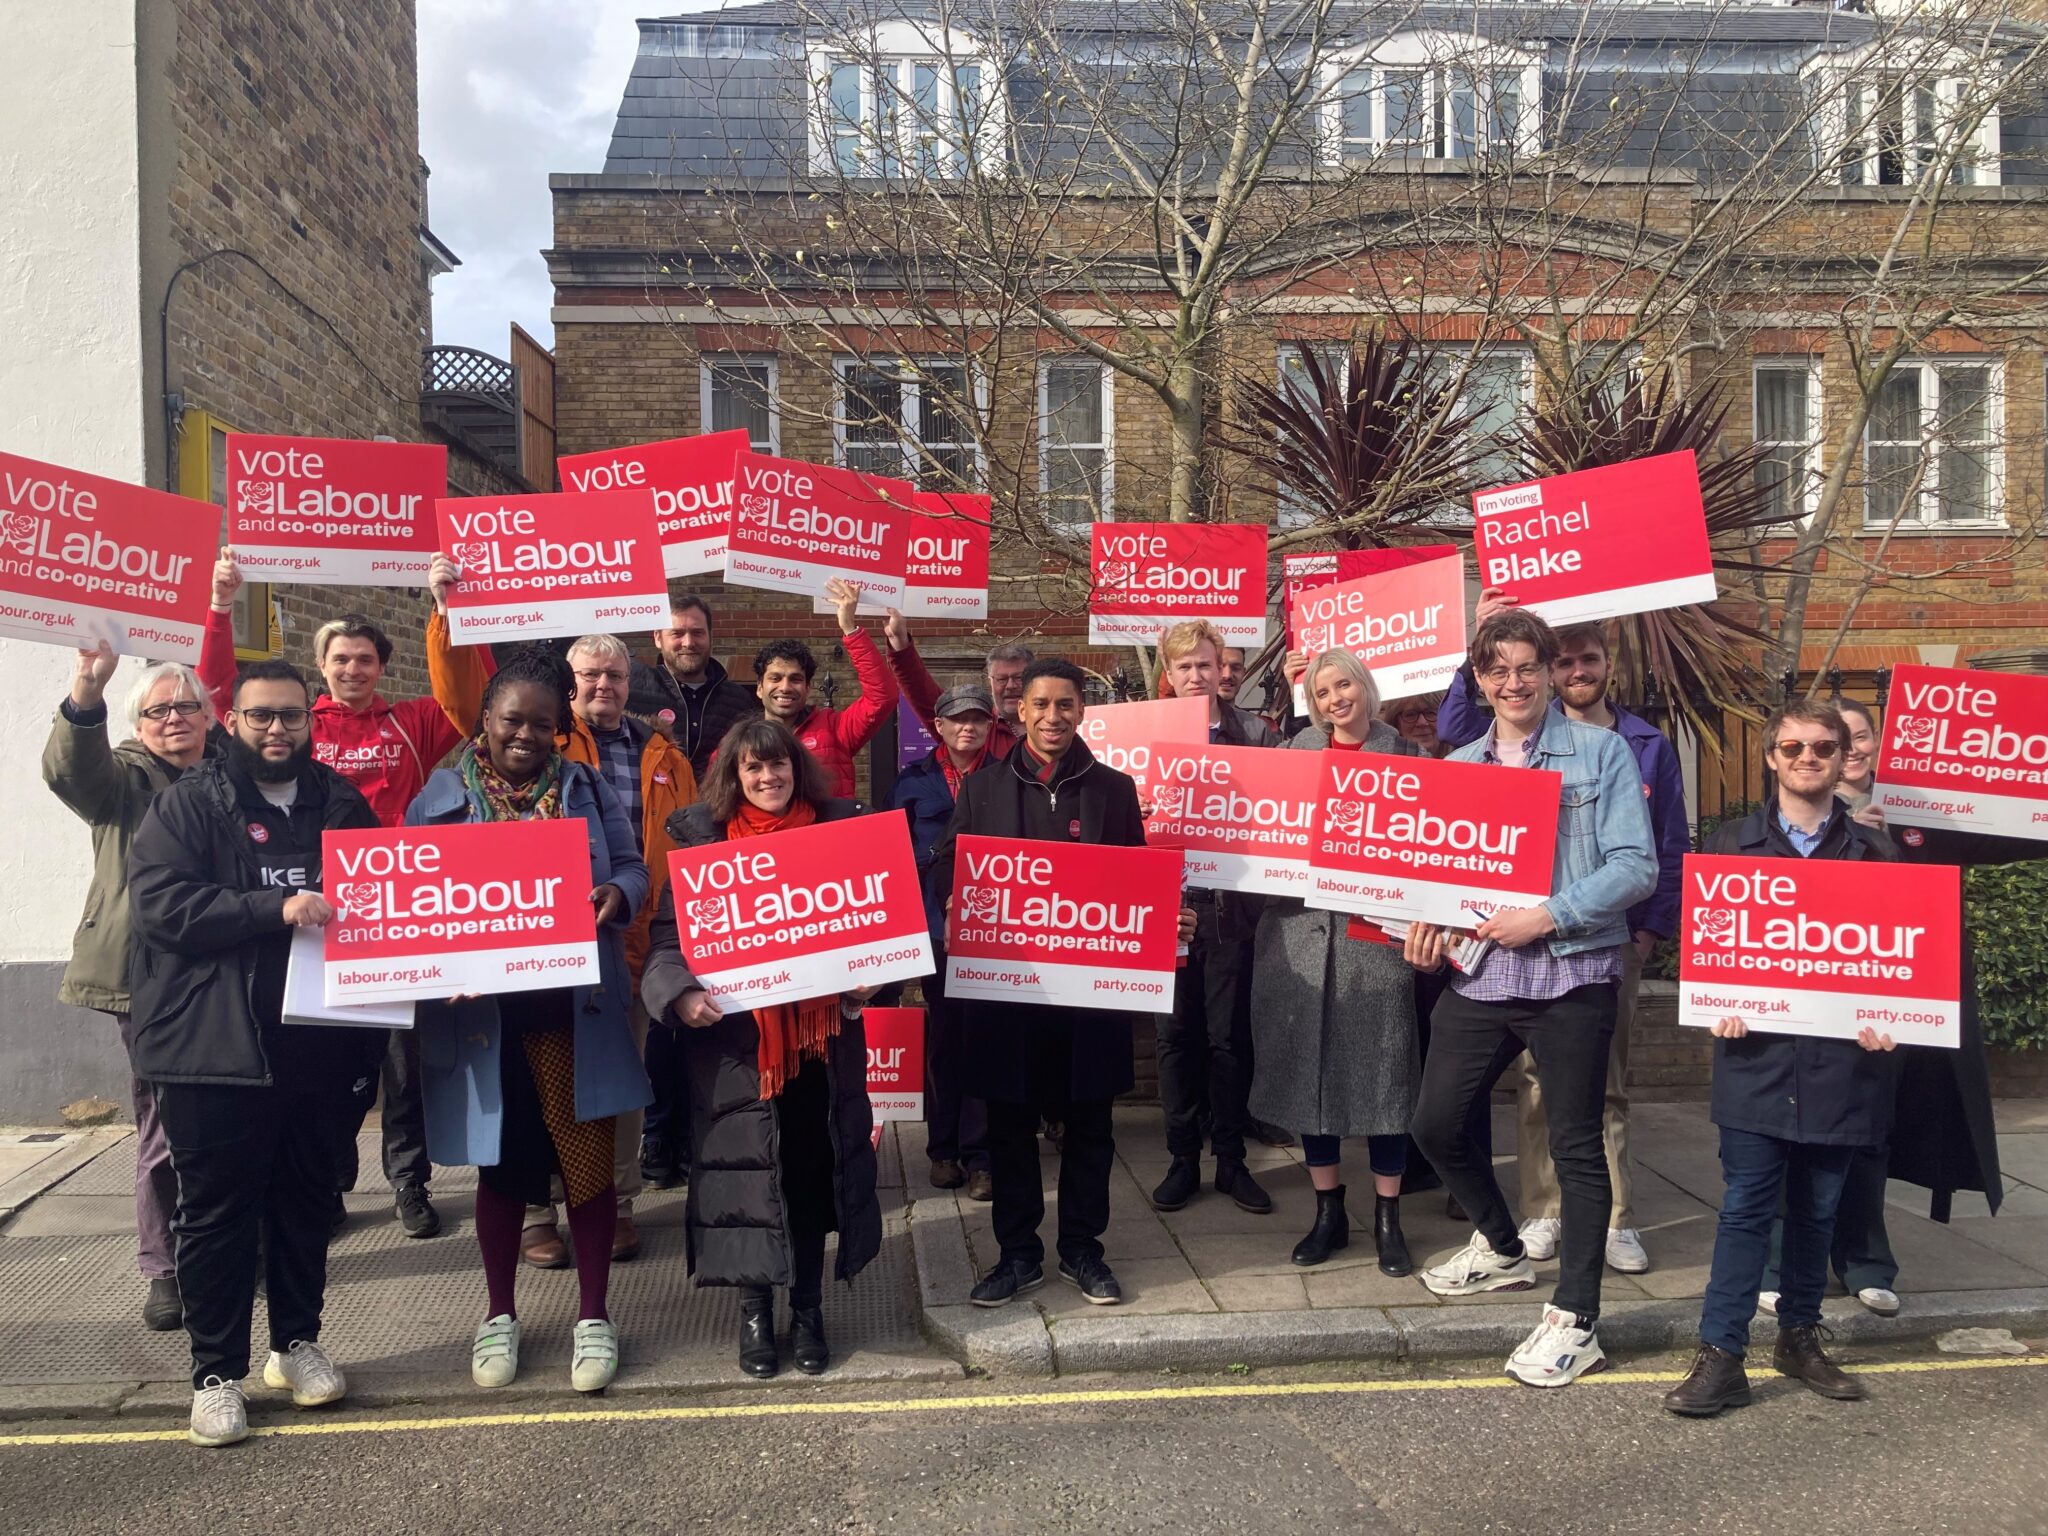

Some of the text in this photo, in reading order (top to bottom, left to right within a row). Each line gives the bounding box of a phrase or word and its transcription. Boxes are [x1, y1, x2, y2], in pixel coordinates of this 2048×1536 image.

[238, 447, 324, 478] vote
[570, 459, 647, 493] vote
[5, 473, 98, 521] vote
[651, 480, 734, 516] bour
[743, 466, 813, 500] vote
[278, 482, 422, 521] Labour
[1480, 493, 1538, 512] I'm Voting
[238, 517, 414, 538] and co-operative
[449, 504, 535, 538] vote
[658, 511, 731, 535] perative
[772, 499, 890, 547] Labour
[1483, 501, 1590, 549] Rachel
[38, 520, 192, 584] Labour
[492, 538, 637, 572] Labour
[737, 526, 881, 561] and co-operative
[908, 537, 970, 561] our
[1101, 531, 1168, 559] vote
[238, 554, 320, 569] labour.org.uk
[733, 560, 802, 581] labour.org.uk
[1130, 560, 1247, 591] Labour
[1488, 547, 1582, 585] Blake
[35, 565, 178, 604] co-operative
[457, 568, 632, 593] and co-operative
[595, 603, 661, 620] party.coop
[927, 596, 980, 606] party.coop
[1129, 592, 1239, 606] co-operative
[1301, 591, 1364, 623] vote
[460, 611, 544, 630] labour.org.uk
[1097, 623, 1162, 635] labour.org.uk
[1219, 625, 1258, 635] ty.coop
[1329, 604, 1443, 648] Labour
[128, 625, 195, 647] party.coop
[1355, 633, 1437, 661] operative
[1403, 663, 1458, 682] party.coop
[1903, 681, 1998, 718] vote
[1936, 719, 2048, 765] Labo
[1157, 754, 1232, 785] vote
[1331, 765, 1421, 801] vote
[1889, 756, 2048, 785] and co-operat
[1186, 796, 1316, 828] Labour
[1883, 794, 1975, 816] labour.org.uk
[1149, 819, 1308, 846] and co-operative
[1364, 808, 1527, 855] Labour
[336, 840, 441, 877] vote
[966, 851, 1053, 886] vote
[1322, 837, 1514, 876] and co-operative
[261, 867, 306, 886] IKE
[680, 851, 777, 893] vote
[386, 877, 563, 919] Labour
[730, 871, 890, 931] Labour
[1317, 877, 1405, 901] labour.org.uk
[1695, 869, 1797, 907] vote
[1002, 889, 1153, 934] Labour
[338, 913, 555, 943] and co-operative
[693, 909, 887, 959] and co-operative
[960, 925, 1142, 955] and co-operative
[1739, 909, 1925, 959] Labour
[505, 955, 587, 974] party.coop
[847, 946, 921, 971] party.coop
[1692, 951, 1913, 981] and co-operative
[338, 966, 442, 985] labour.org.uk
[708, 970, 792, 997] bour.org.uk
[955, 967, 1041, 986] labour.org.uk
[1094, 978, 1164, 995] party.coop
[1691, 993, 1791, 1015] labour.org.uk
[1856, 1007, 1946, 1026] party.coop
